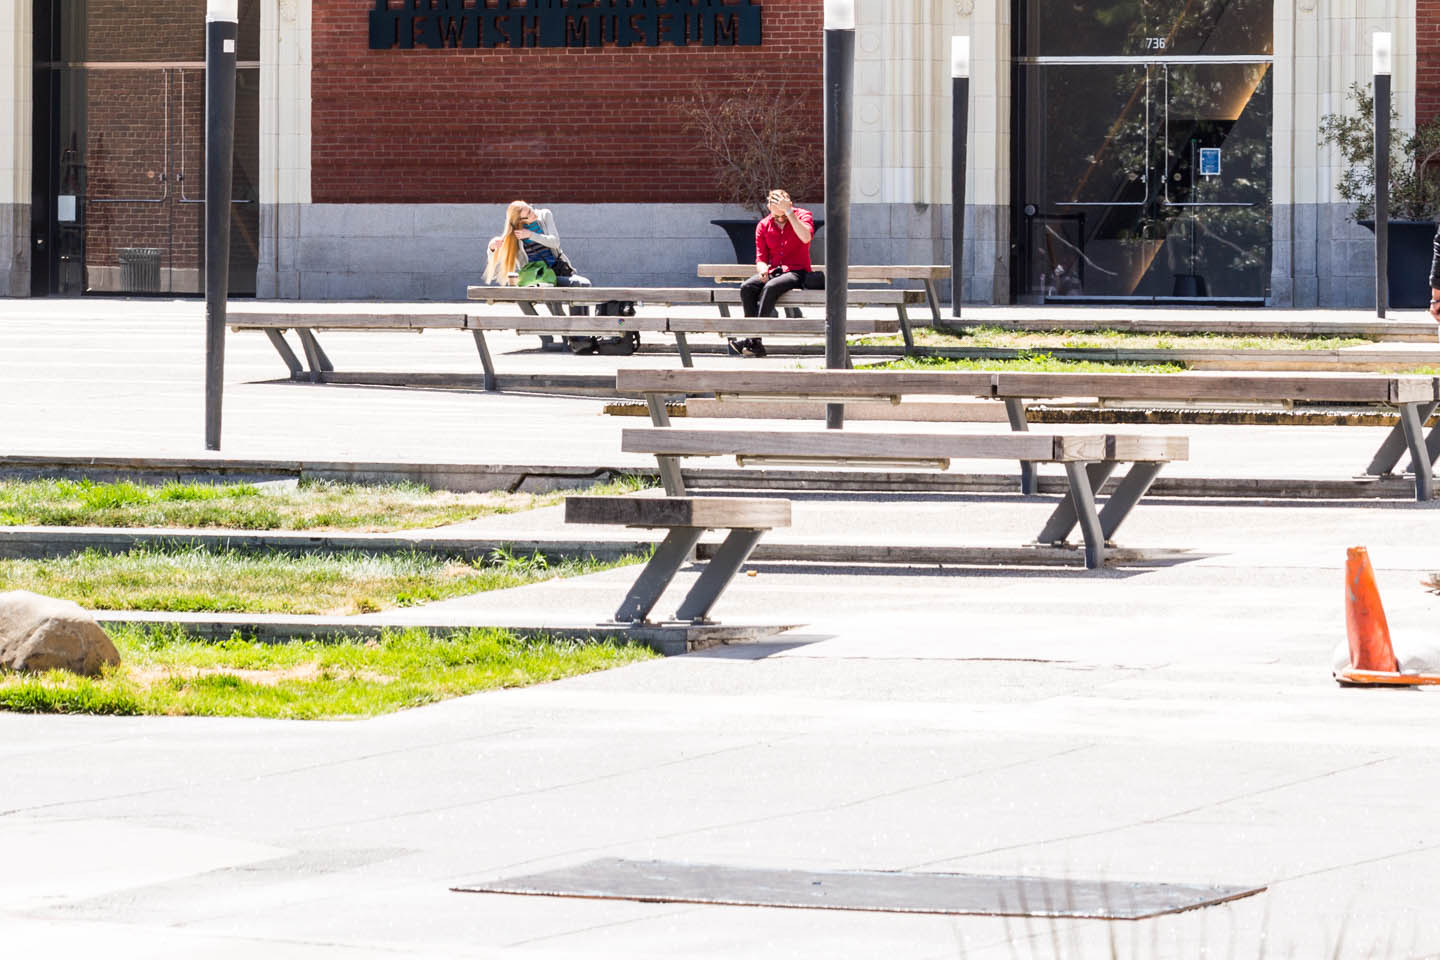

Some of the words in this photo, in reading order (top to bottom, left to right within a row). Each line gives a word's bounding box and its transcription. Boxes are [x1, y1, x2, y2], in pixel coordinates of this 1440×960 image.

[391, 12, 540, 48] JEWISH
[566, 12, 740, 47] MUSEUM
[1145, 37, 1166, 49] 736
